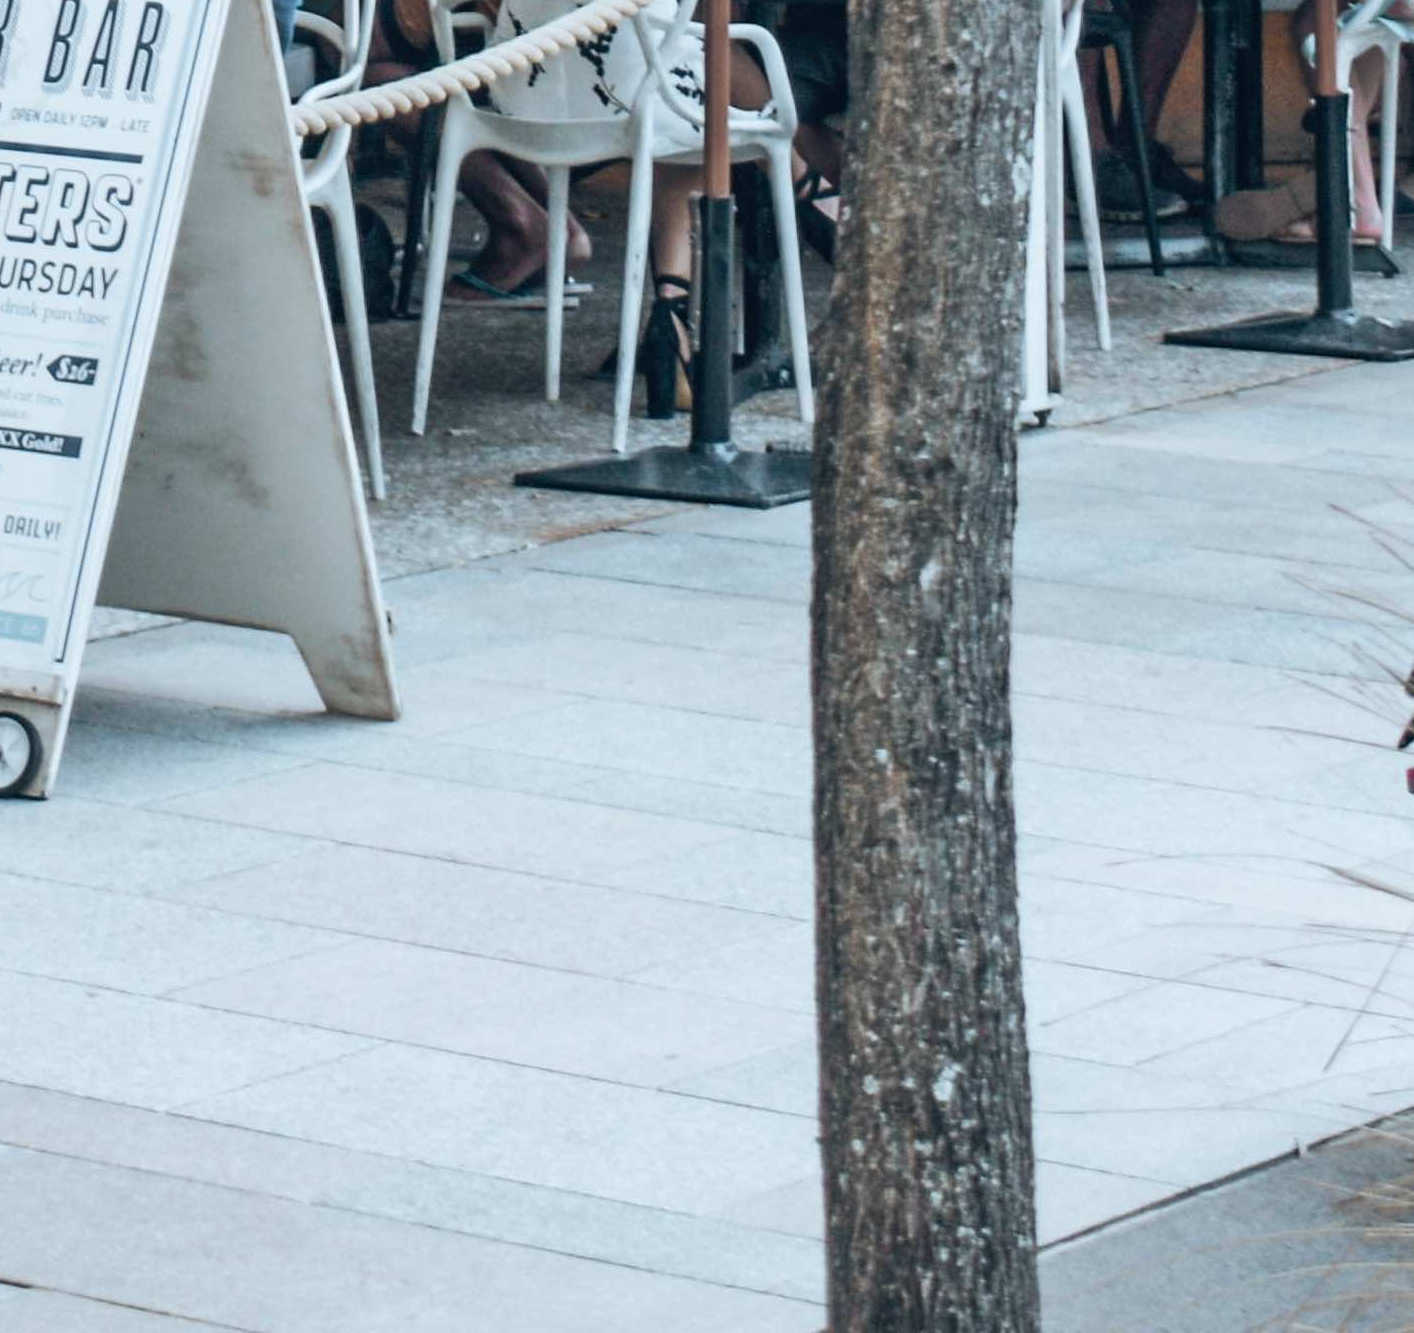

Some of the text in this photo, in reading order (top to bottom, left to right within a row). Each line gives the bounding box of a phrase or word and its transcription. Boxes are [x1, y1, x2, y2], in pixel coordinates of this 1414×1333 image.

[0, 297, 38, 318] drink
[41, 305, 112, 327] purchase
[21, 432, 65, 453] Gold!
[3, 514, 62, 542] DAILY!
